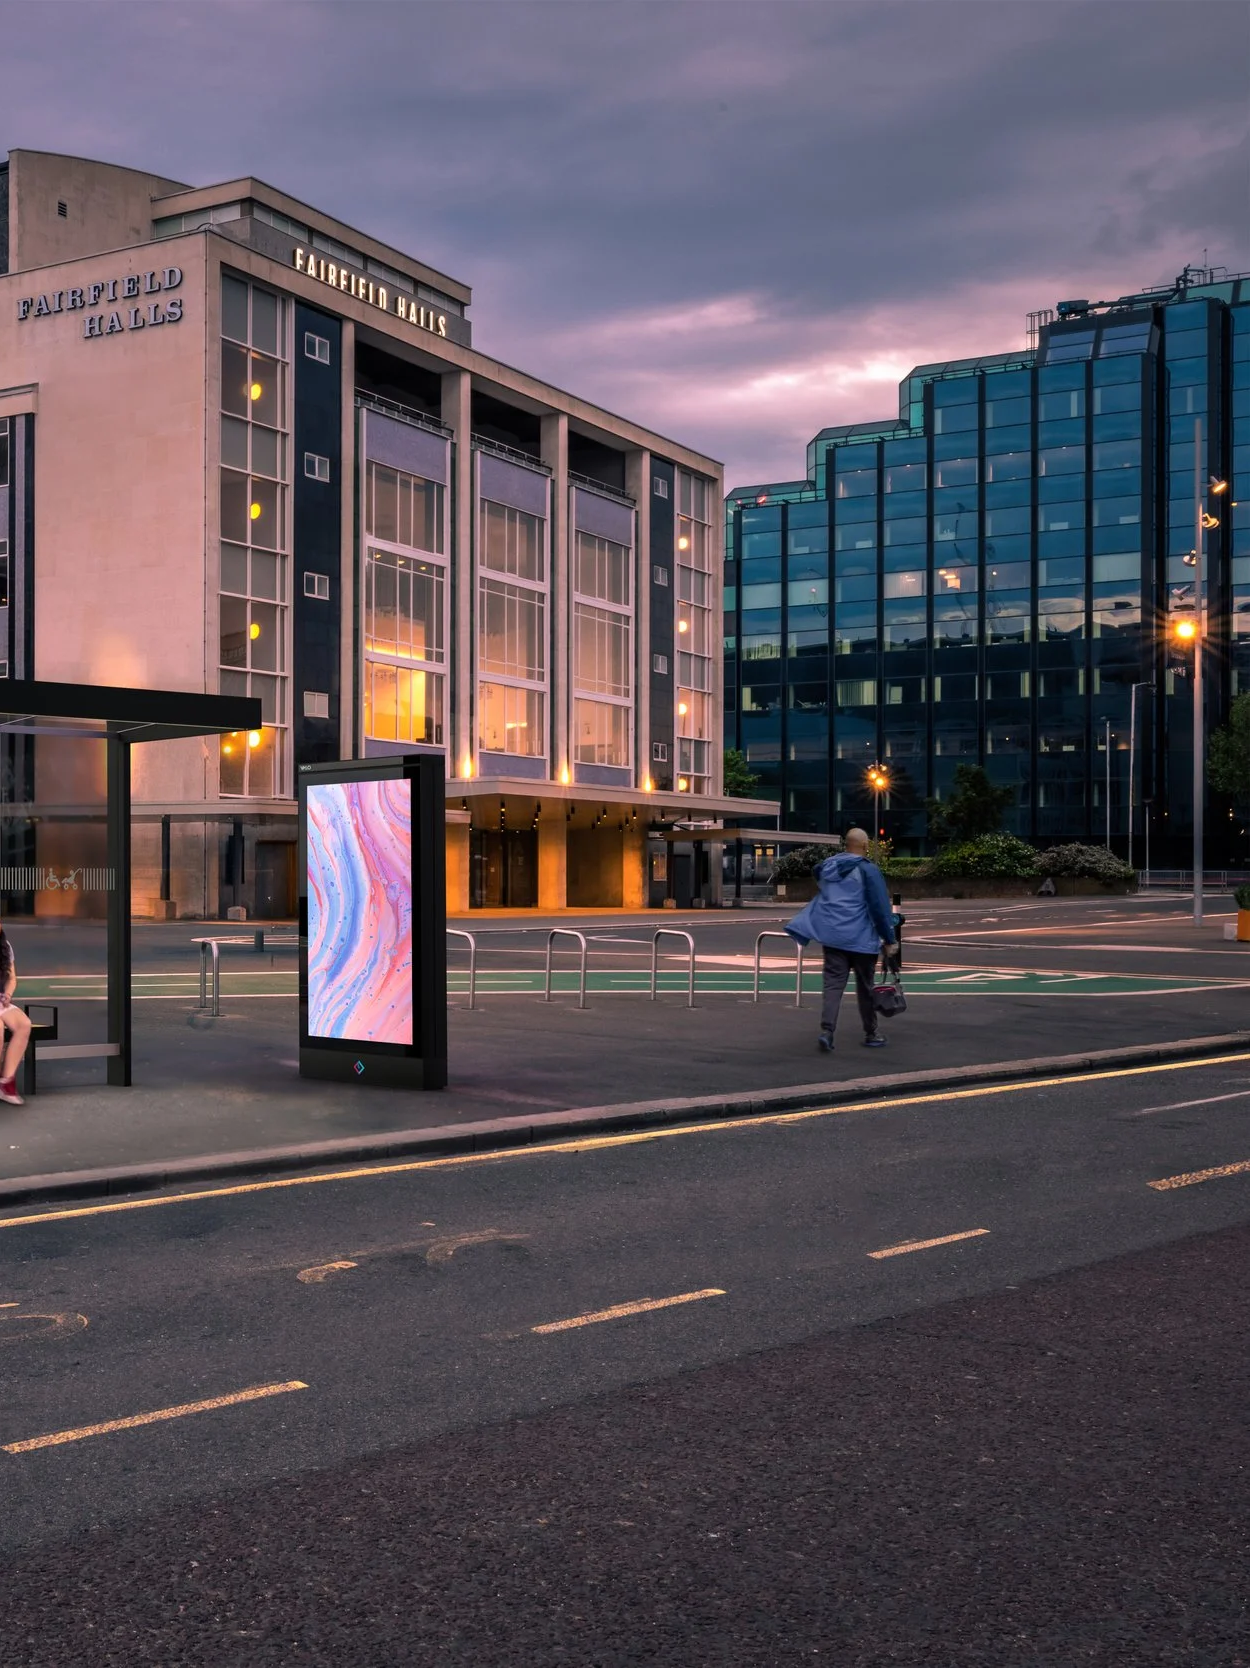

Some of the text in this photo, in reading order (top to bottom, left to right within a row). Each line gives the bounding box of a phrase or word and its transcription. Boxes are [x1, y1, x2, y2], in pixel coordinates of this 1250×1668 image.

[17, 266, 183, 321] FAIRFIELD
[83, 299, 183, 338] HALLS
[292, 248, 447, 337] FAIRFIELD HALLS
